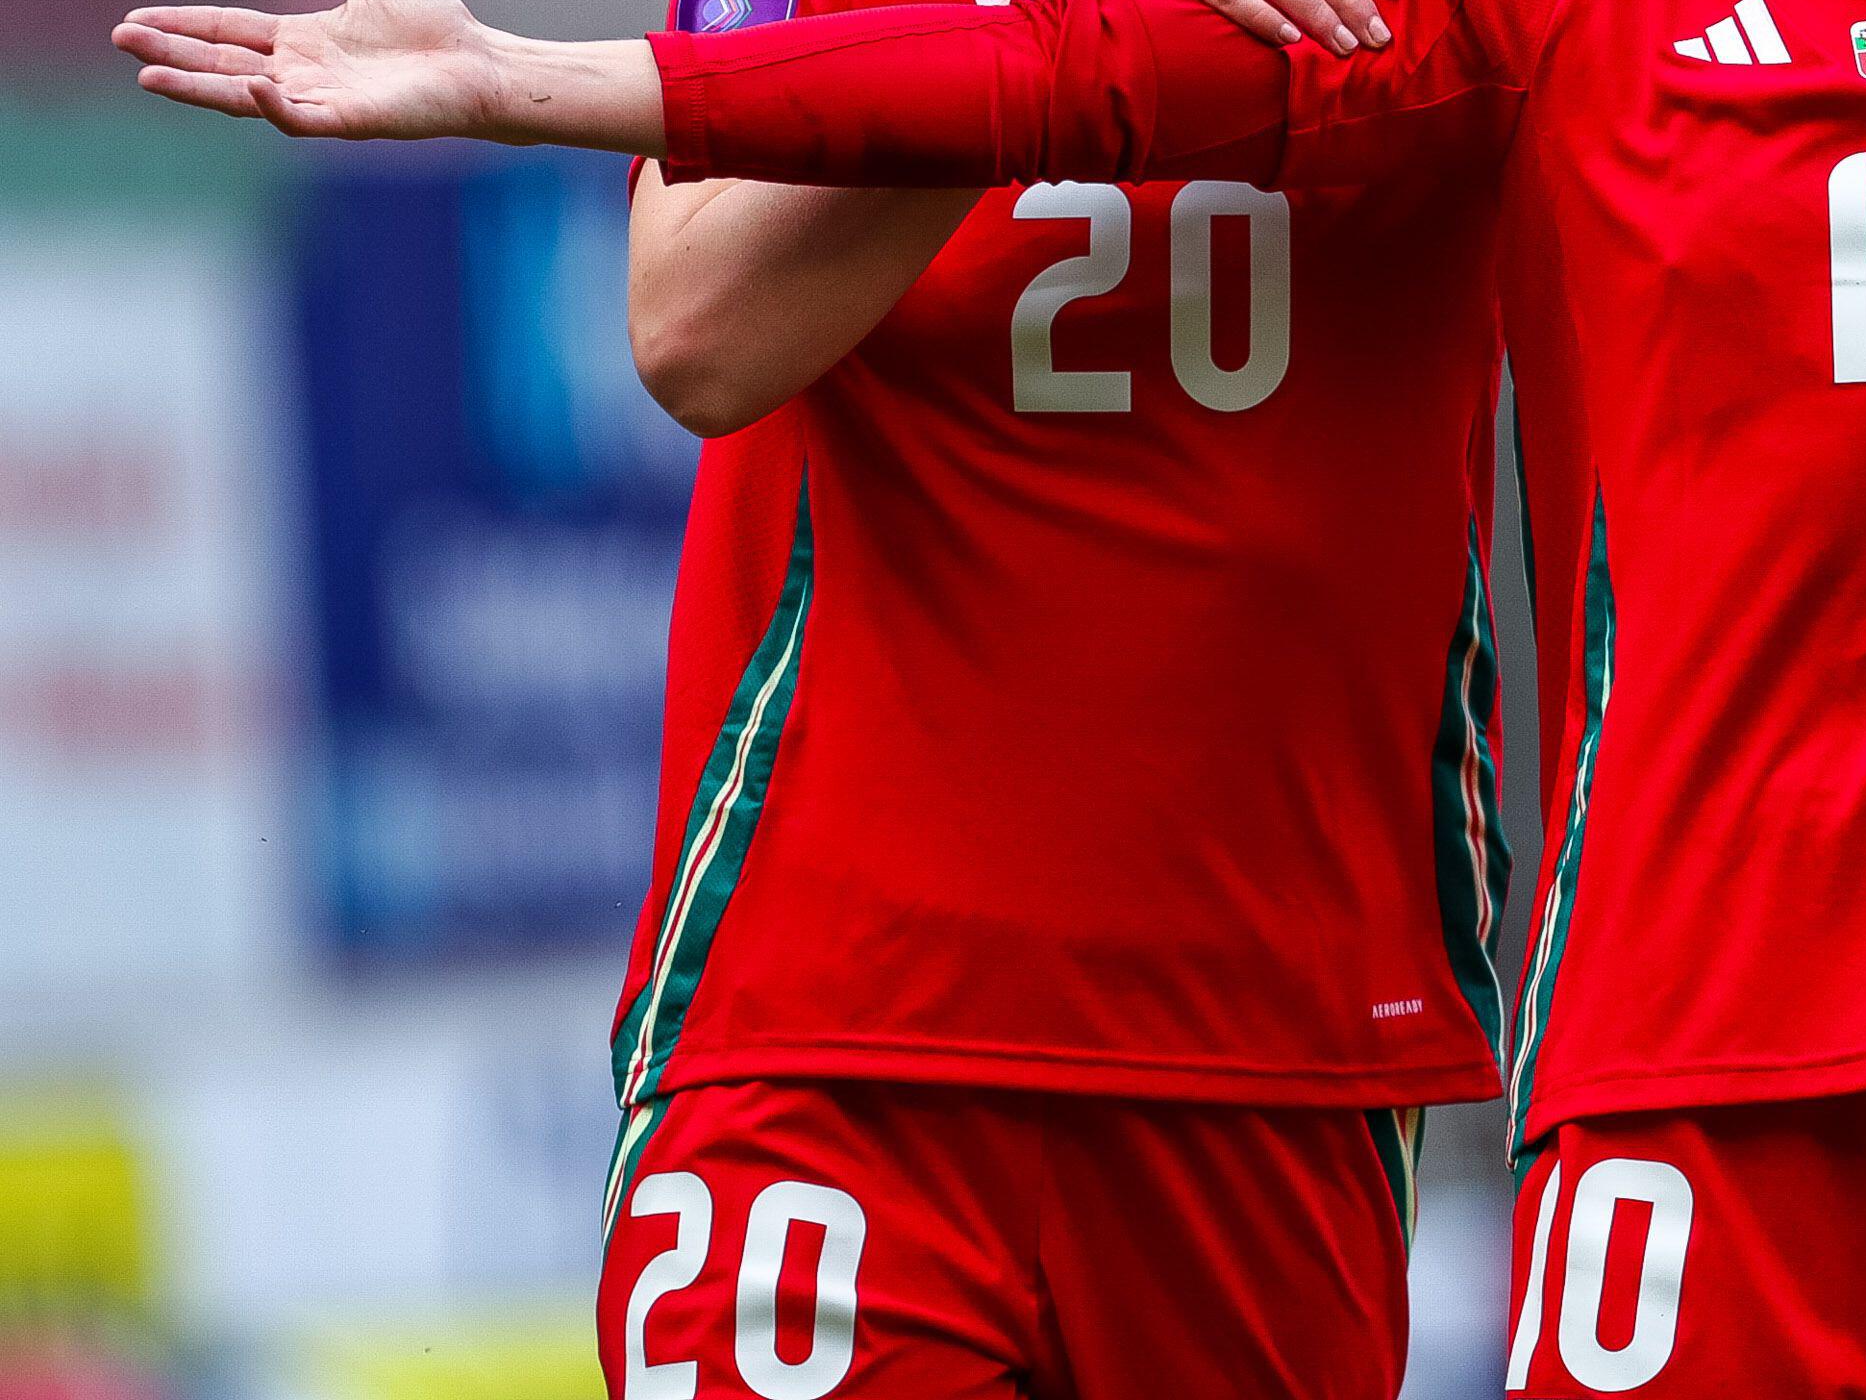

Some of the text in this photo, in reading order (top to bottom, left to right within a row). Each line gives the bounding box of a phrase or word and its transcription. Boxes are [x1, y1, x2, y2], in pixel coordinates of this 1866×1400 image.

[1011, 180, 1290, 412] 20
[1372, 999, 1423, 1019] AEROREADY
[624, 1171, 867, 1400] 20
[1505, 1158, 1694, 1393] 10
